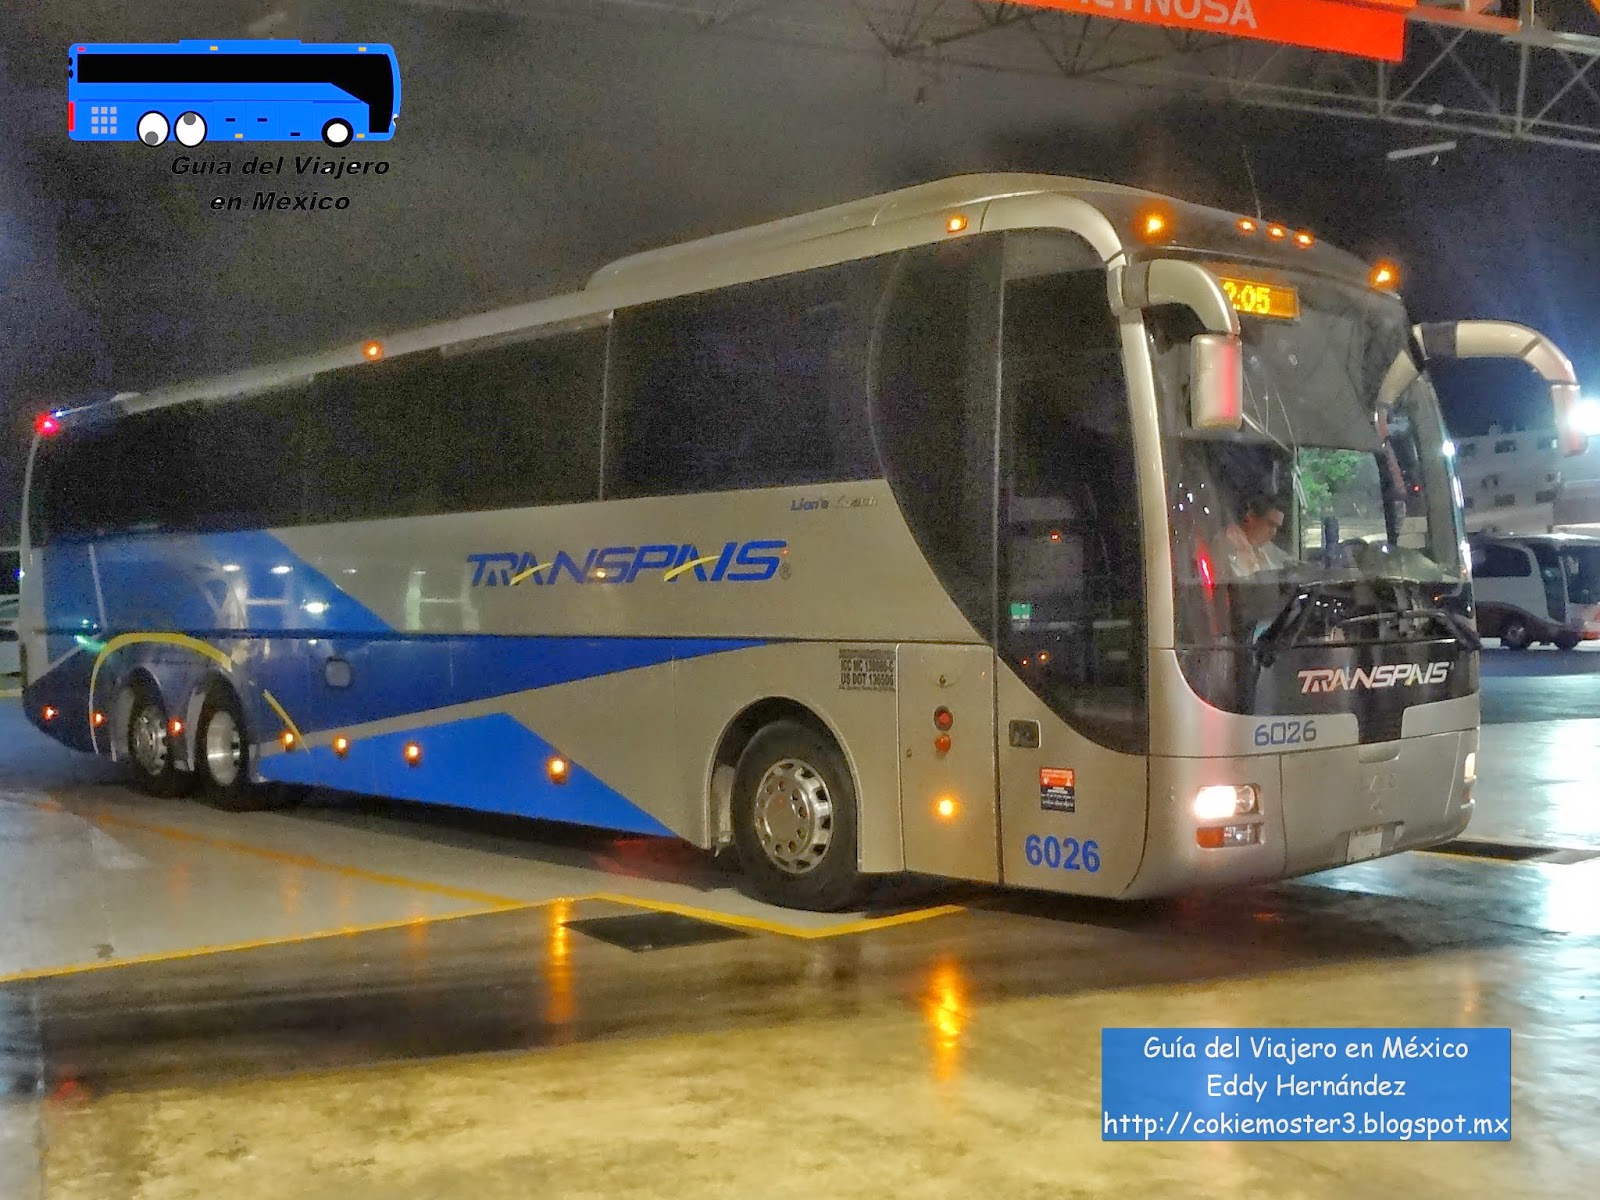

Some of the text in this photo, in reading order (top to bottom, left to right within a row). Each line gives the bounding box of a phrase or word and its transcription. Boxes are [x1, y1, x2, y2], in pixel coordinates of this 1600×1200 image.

[1079, 0, 1258, 29] NOSA
[841, 673, 850, 684] US
[852, 673, 867, 685] DOT
[1254, 720, 1317, 746] 6026
[1025, 834, 1101, 873] 6026
